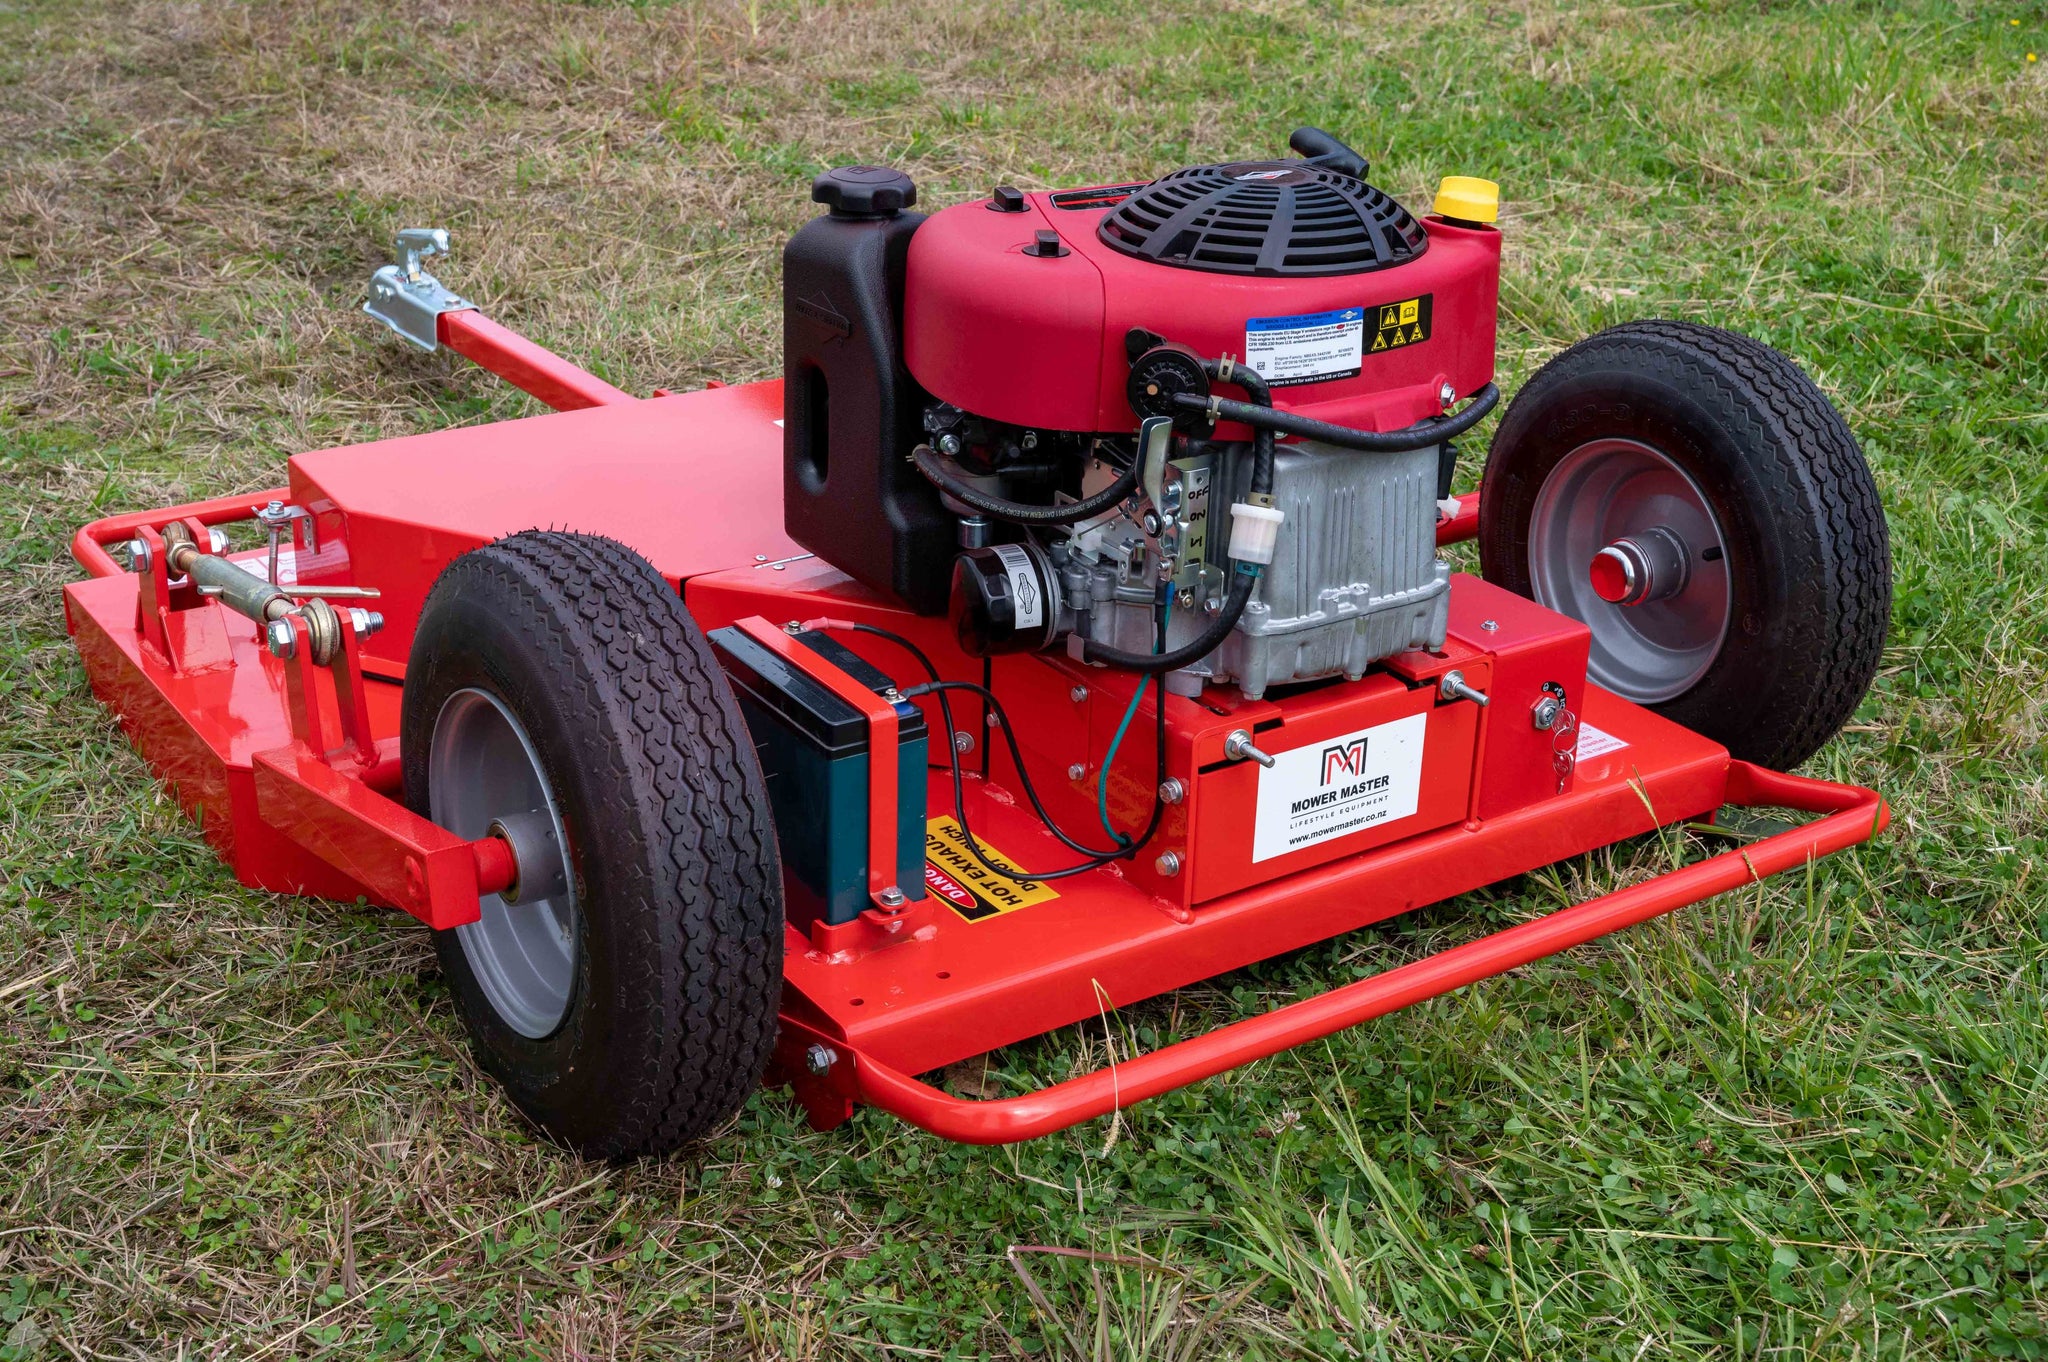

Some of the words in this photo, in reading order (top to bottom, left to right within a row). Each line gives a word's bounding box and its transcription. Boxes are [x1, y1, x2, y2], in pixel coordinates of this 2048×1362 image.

[1188, 485, 1209, 500] OFF
[1190, 509, 1206, 521] ON
[1291, 791, 1337, 814] MOWER
[1340, 775, 1389, 799] MASTER
[1289, 810, 1387, 845] www.mowermaster.co.nz
[1290, 811, 1335, 829] LIFESTYLE
[1339, 795, 1388, 814] EQUIPMENT
[926, 833, 988, 881] EXHAUS
[925, 865, 967, 899] DANG
[979, 881, 1024, 906] HOT
